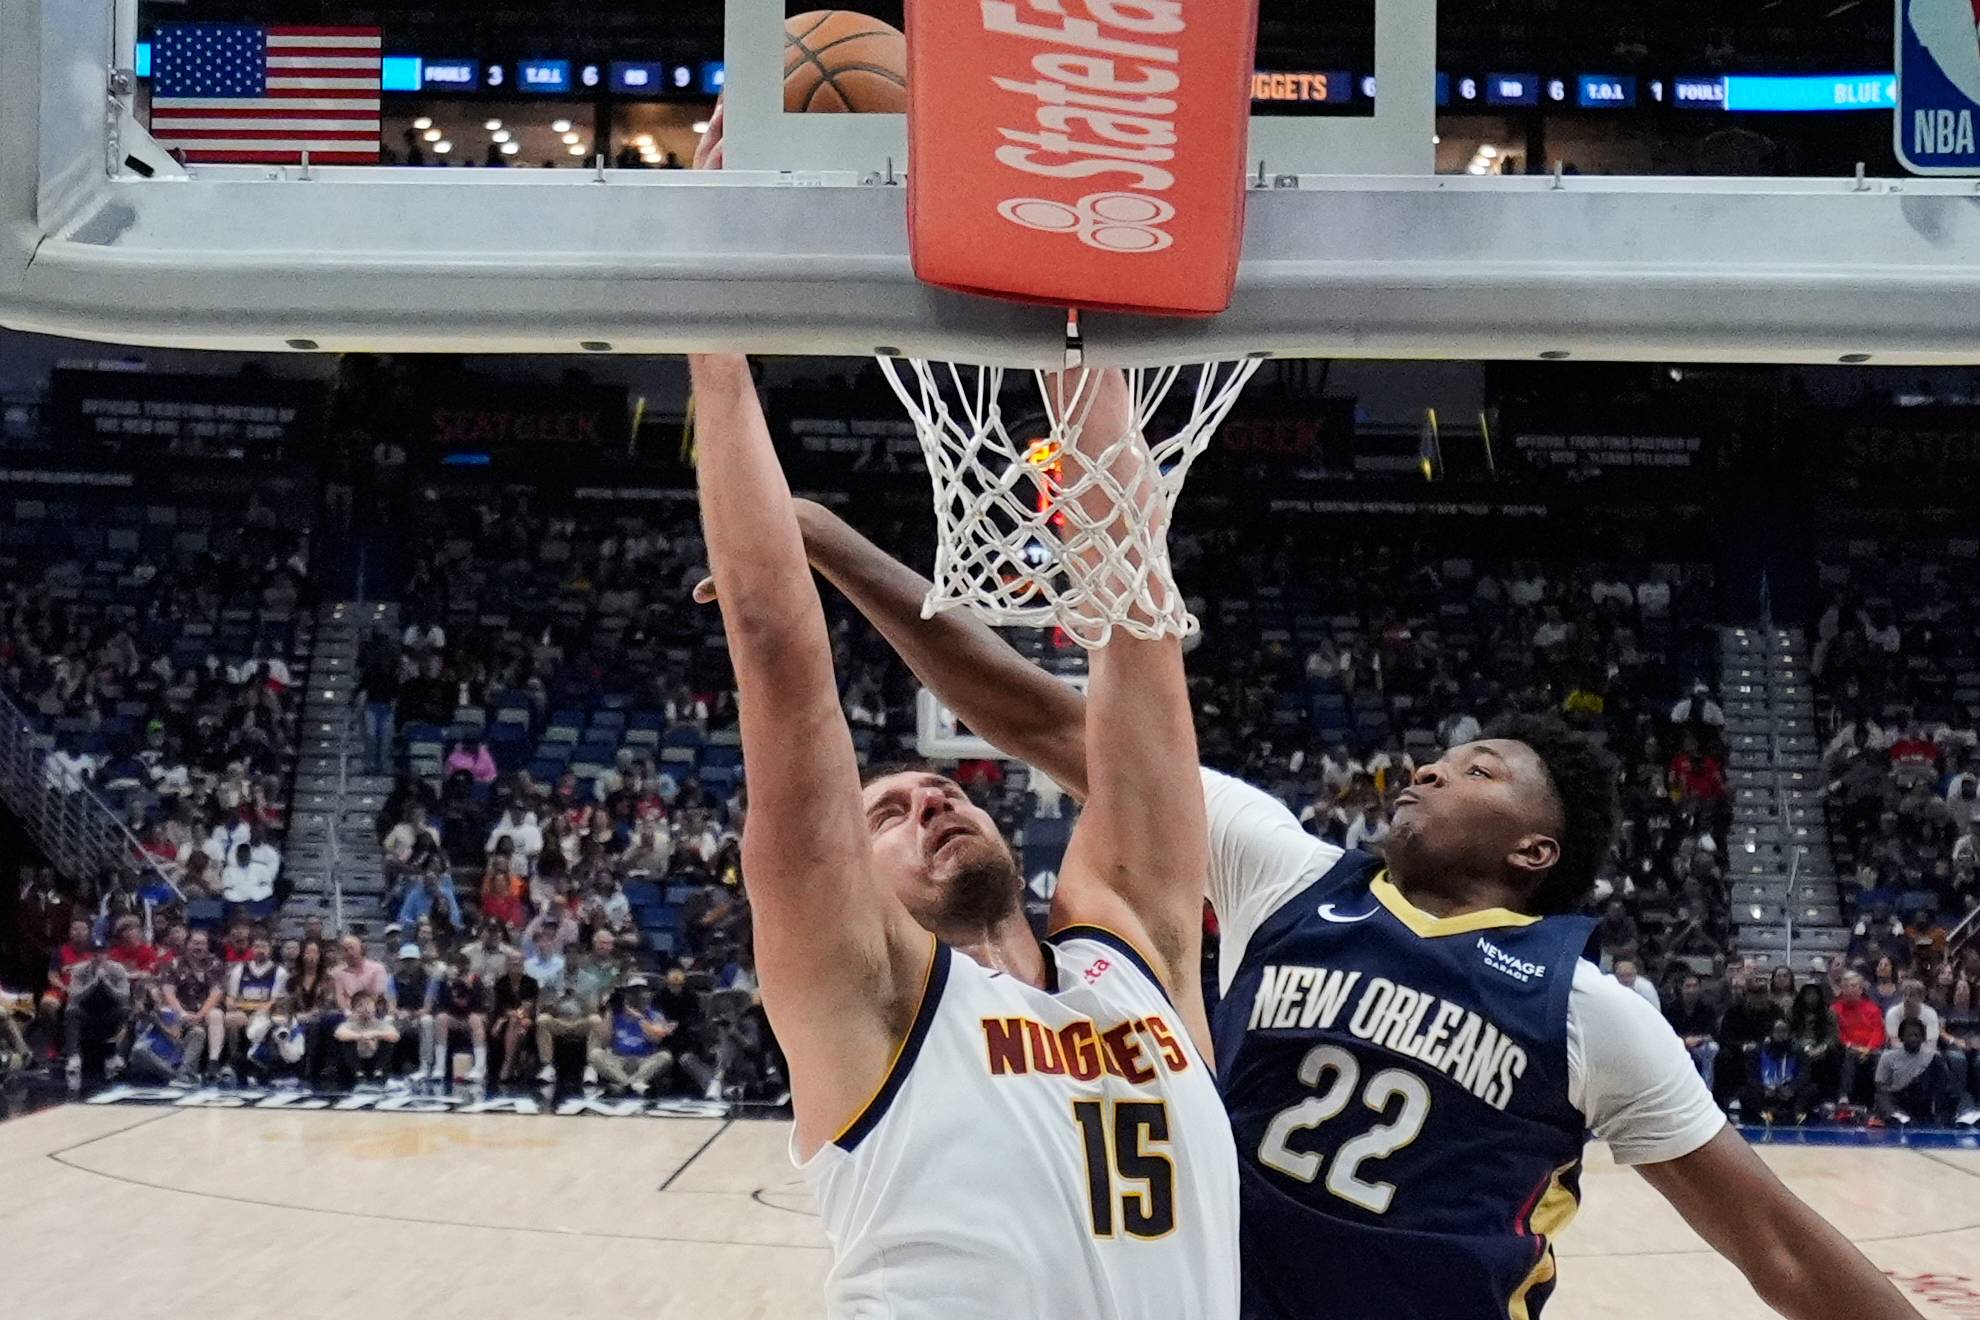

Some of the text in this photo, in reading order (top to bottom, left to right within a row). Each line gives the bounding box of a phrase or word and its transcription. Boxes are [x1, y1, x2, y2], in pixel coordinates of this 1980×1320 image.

[487, 65, 503, 86] 3
[582, 65, 599, 87] 6
[674, 66, 691, 88] 9
[1251, 73, 1328, 101] GGETS
[1460, 78, 1477, 100] 6
[1549, 80, 1565, 101] 6
[1652, 81, 1663, 102] 1
[1677, 83, 1724, 101] FOULS
[1834, 82, 1881, 104] BLUE
[1914, 109, 1976, 154] NBA
[1483, 957, 1529, 983] GARAGE
[1247, 965, 1529, 1112] NEW ORLEANS
[982, 1014, 1188, 1086] NUGES
[1257, 1043, 1432, 1215] 22
[1068, 1098, 1177, 1241] 15
